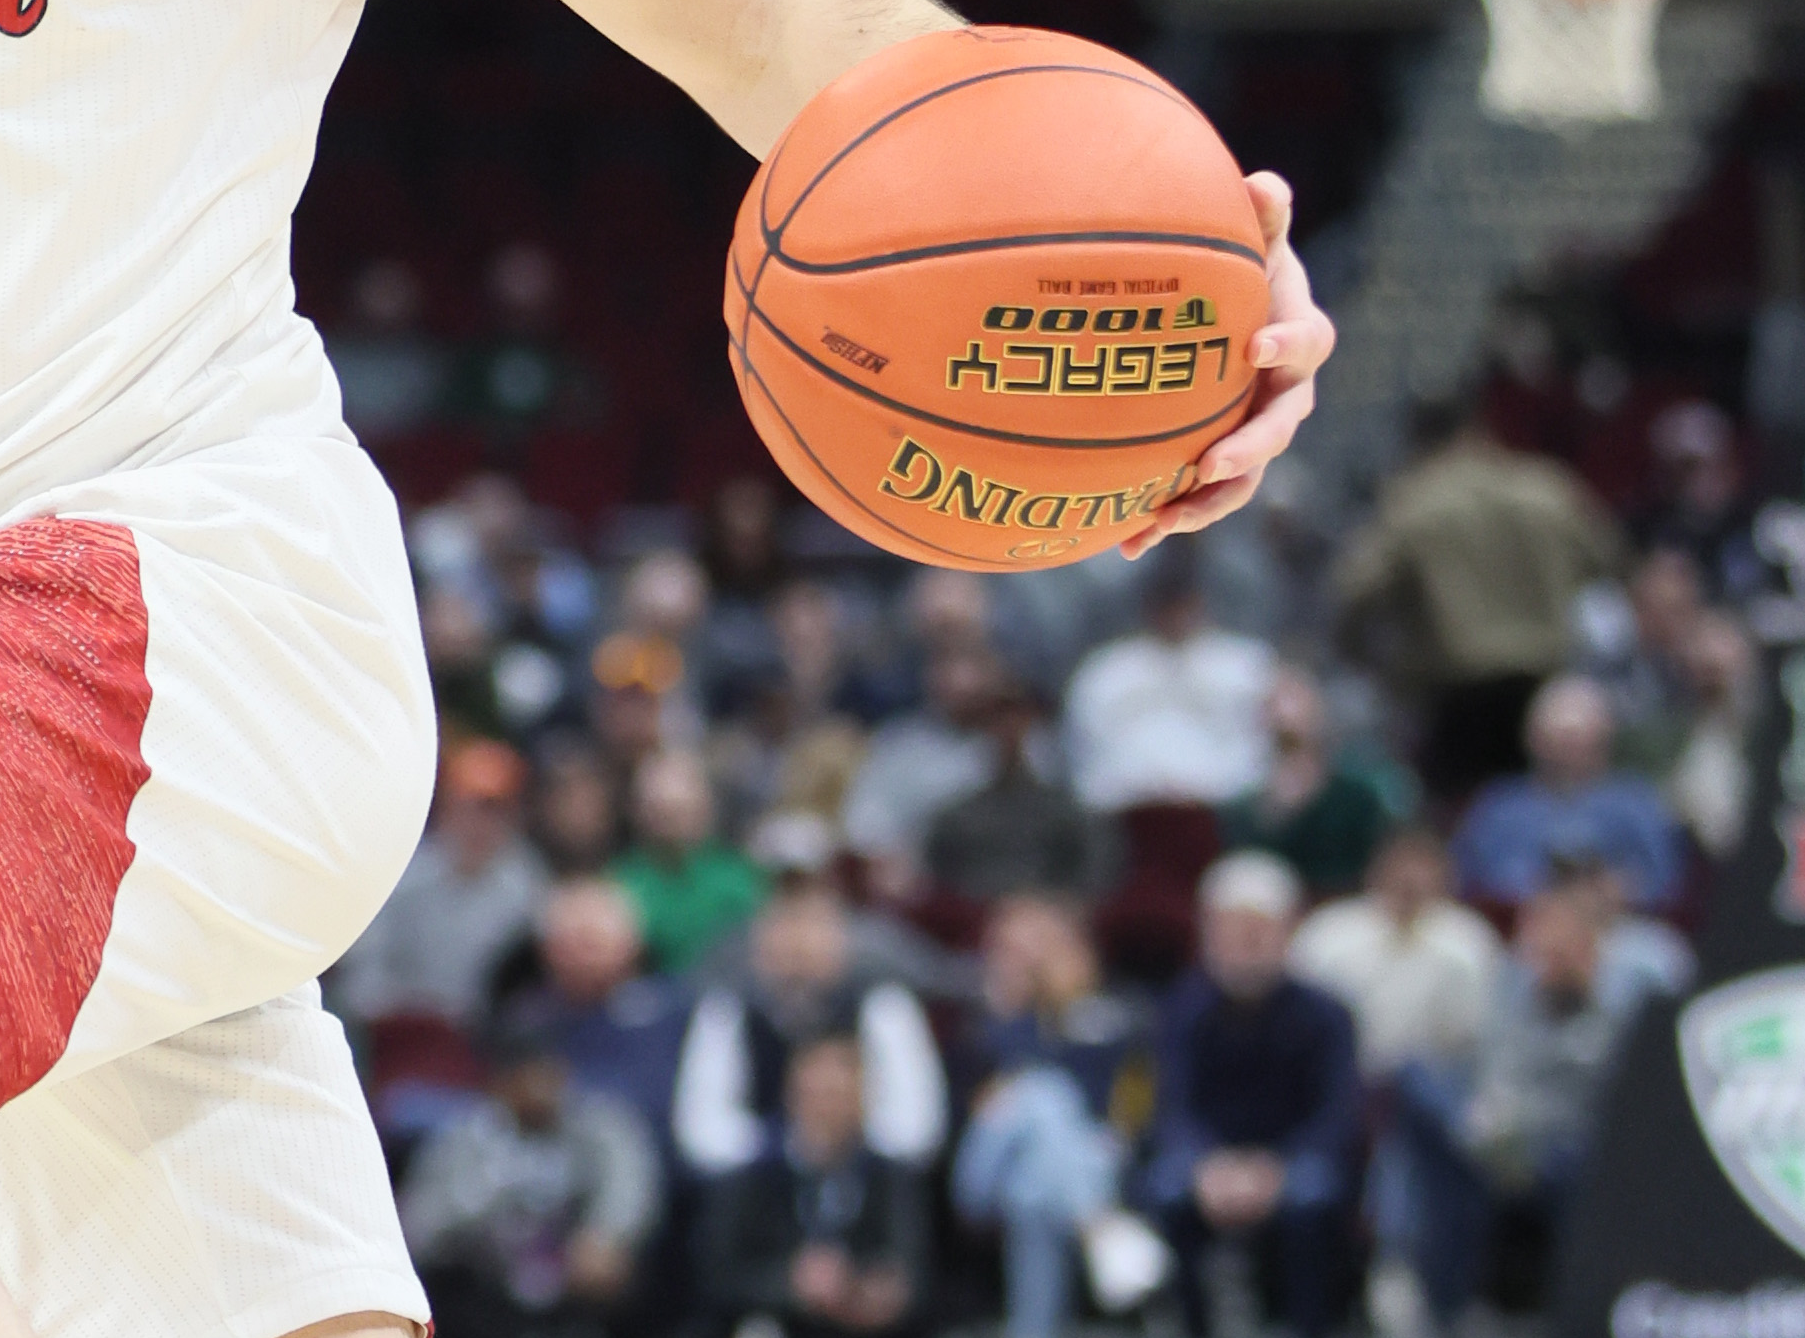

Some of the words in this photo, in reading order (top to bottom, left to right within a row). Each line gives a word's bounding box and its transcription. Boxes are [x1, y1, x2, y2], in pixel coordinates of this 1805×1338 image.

[1037, 279, 1072, 296] BALL
[1078, 279, 1116, 296] GAME
[1123, 277, 1179, 295] OFFICIAL
[981, 305, 1163, 334] 1000
[1174, 297, 1216, 328] TF
[946, 337, 1229, 396] LEGACY
[878, 436, 1199, 531] PALDING
